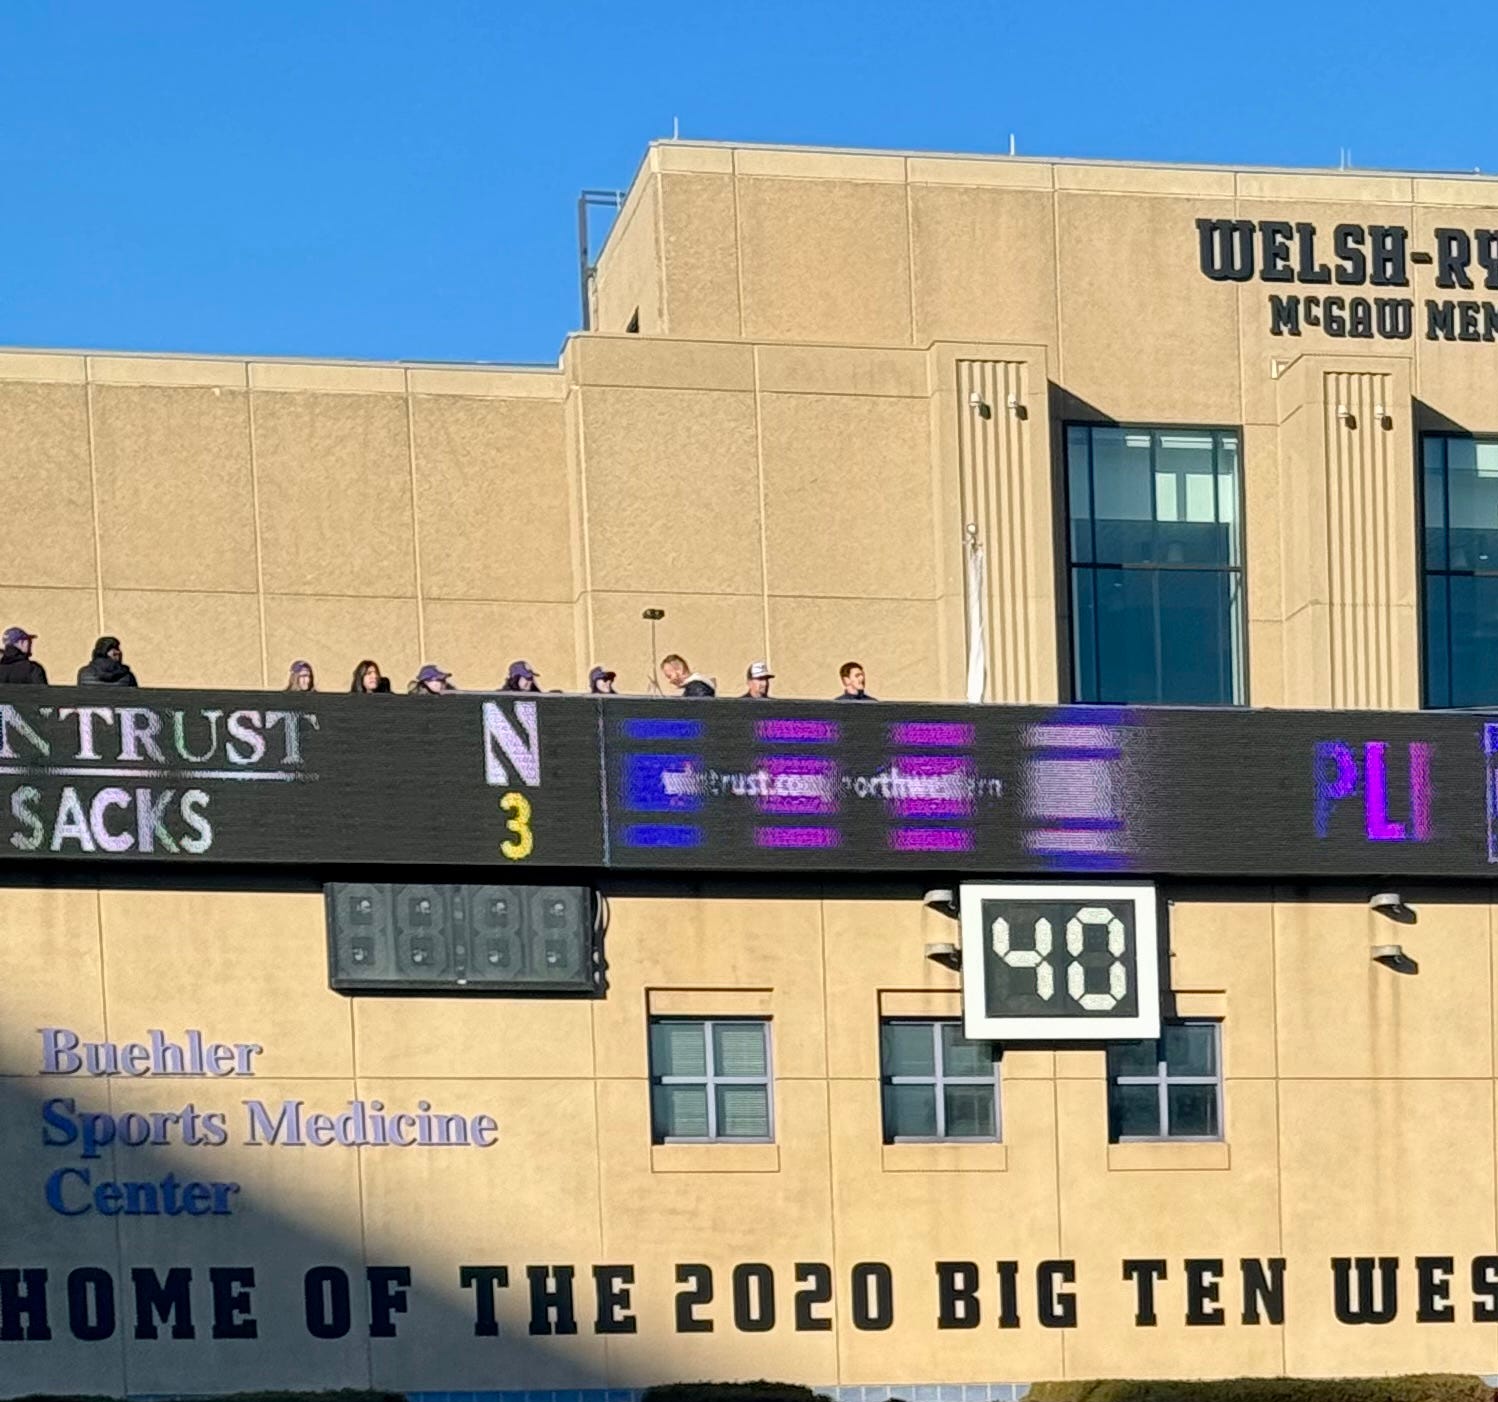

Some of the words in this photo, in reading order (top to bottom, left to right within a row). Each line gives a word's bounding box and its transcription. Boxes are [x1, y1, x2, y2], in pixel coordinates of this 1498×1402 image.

[483, 702, 541, 787] N
[10, 785, 213, 854] SACKS
[500, 792, 533, 860] 3
[991, 906, 1126, 1011] 40
[39, 1028, 263, 1077] Buehler
[41, 1097, 227, 1157] Sports
[243, 1100, 499, 1148] Medicine
[44, 1167, 240, 1216] Center
[0, 1266, 258, 1341] HOME
[304, 1265, 412, 1338] OF
[460, 1264, 637, 1335] THE
[675, 1261, 894, 1333] 2020
[935, 1259, 1078, 1330] BIG
[1122, 1257, 1287, 1327] TEN
